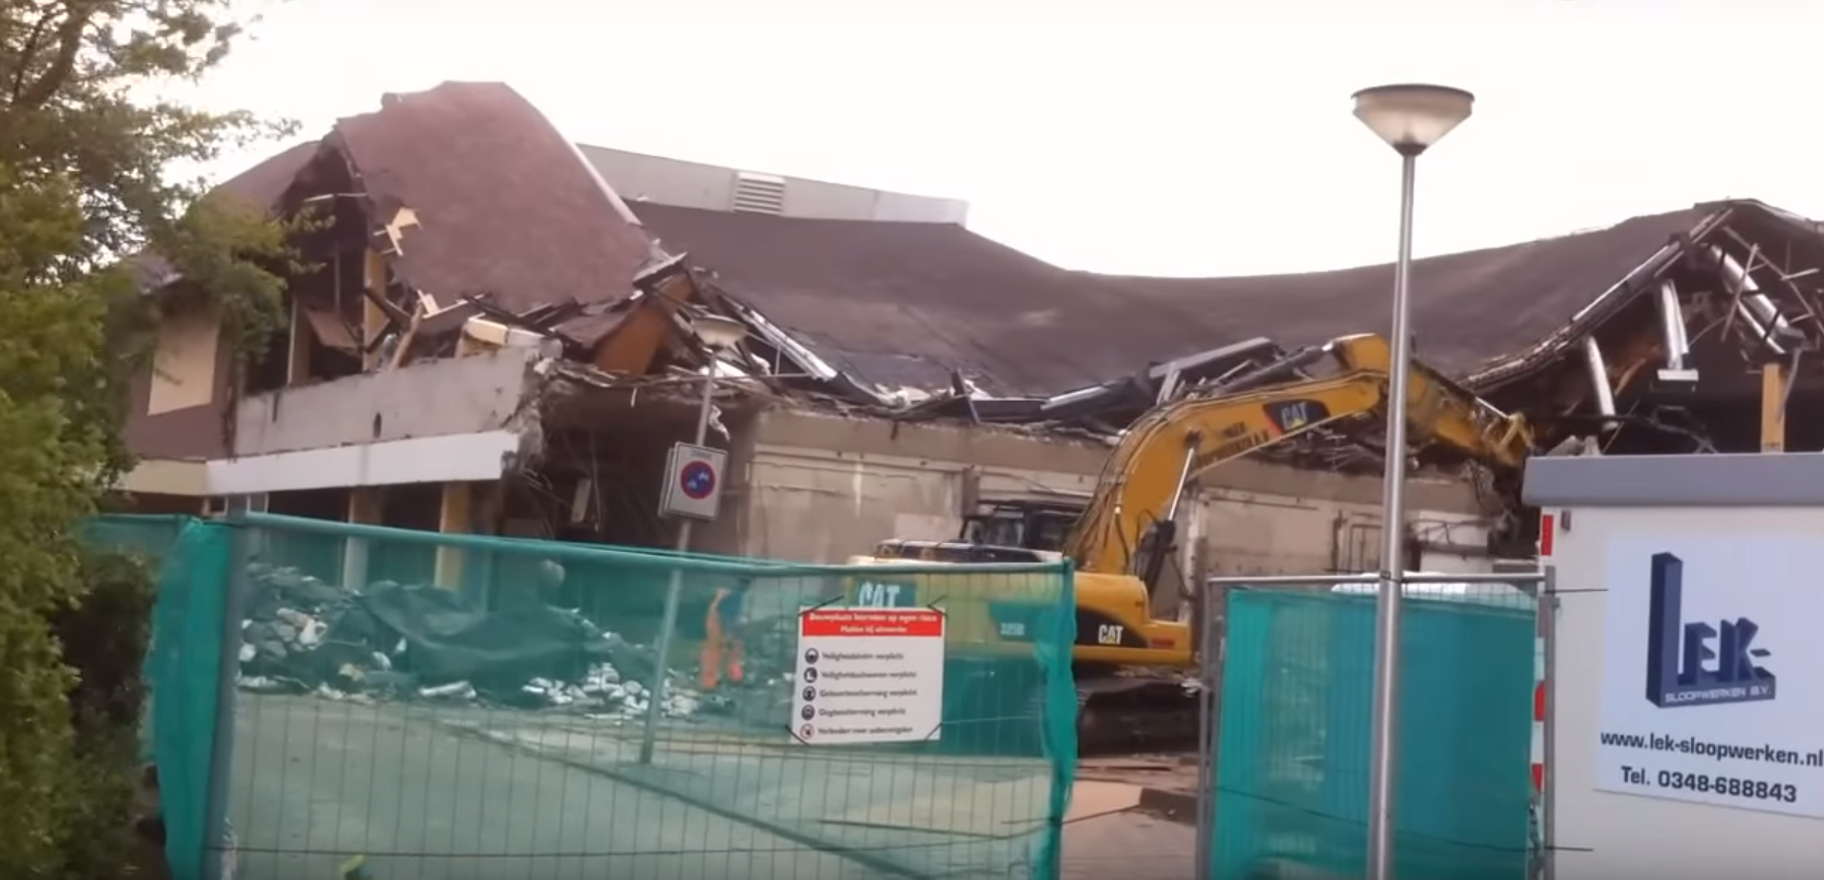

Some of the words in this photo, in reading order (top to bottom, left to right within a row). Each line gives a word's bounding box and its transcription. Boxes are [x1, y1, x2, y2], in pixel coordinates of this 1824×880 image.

[1281, 401, 1308, 430] CAT
[859, 580, 900, 608] CAT
[1098, 624, 1123, 645] CAT
[1664, 687, 1746, 704] SLOOPWERKEN
[1601, 732, 1824, 767] www.lek-sloopwerken.nl
[1621, 766, 1651, 786] Tel.
[1658, 770, 1798, 803] 0348-688843
